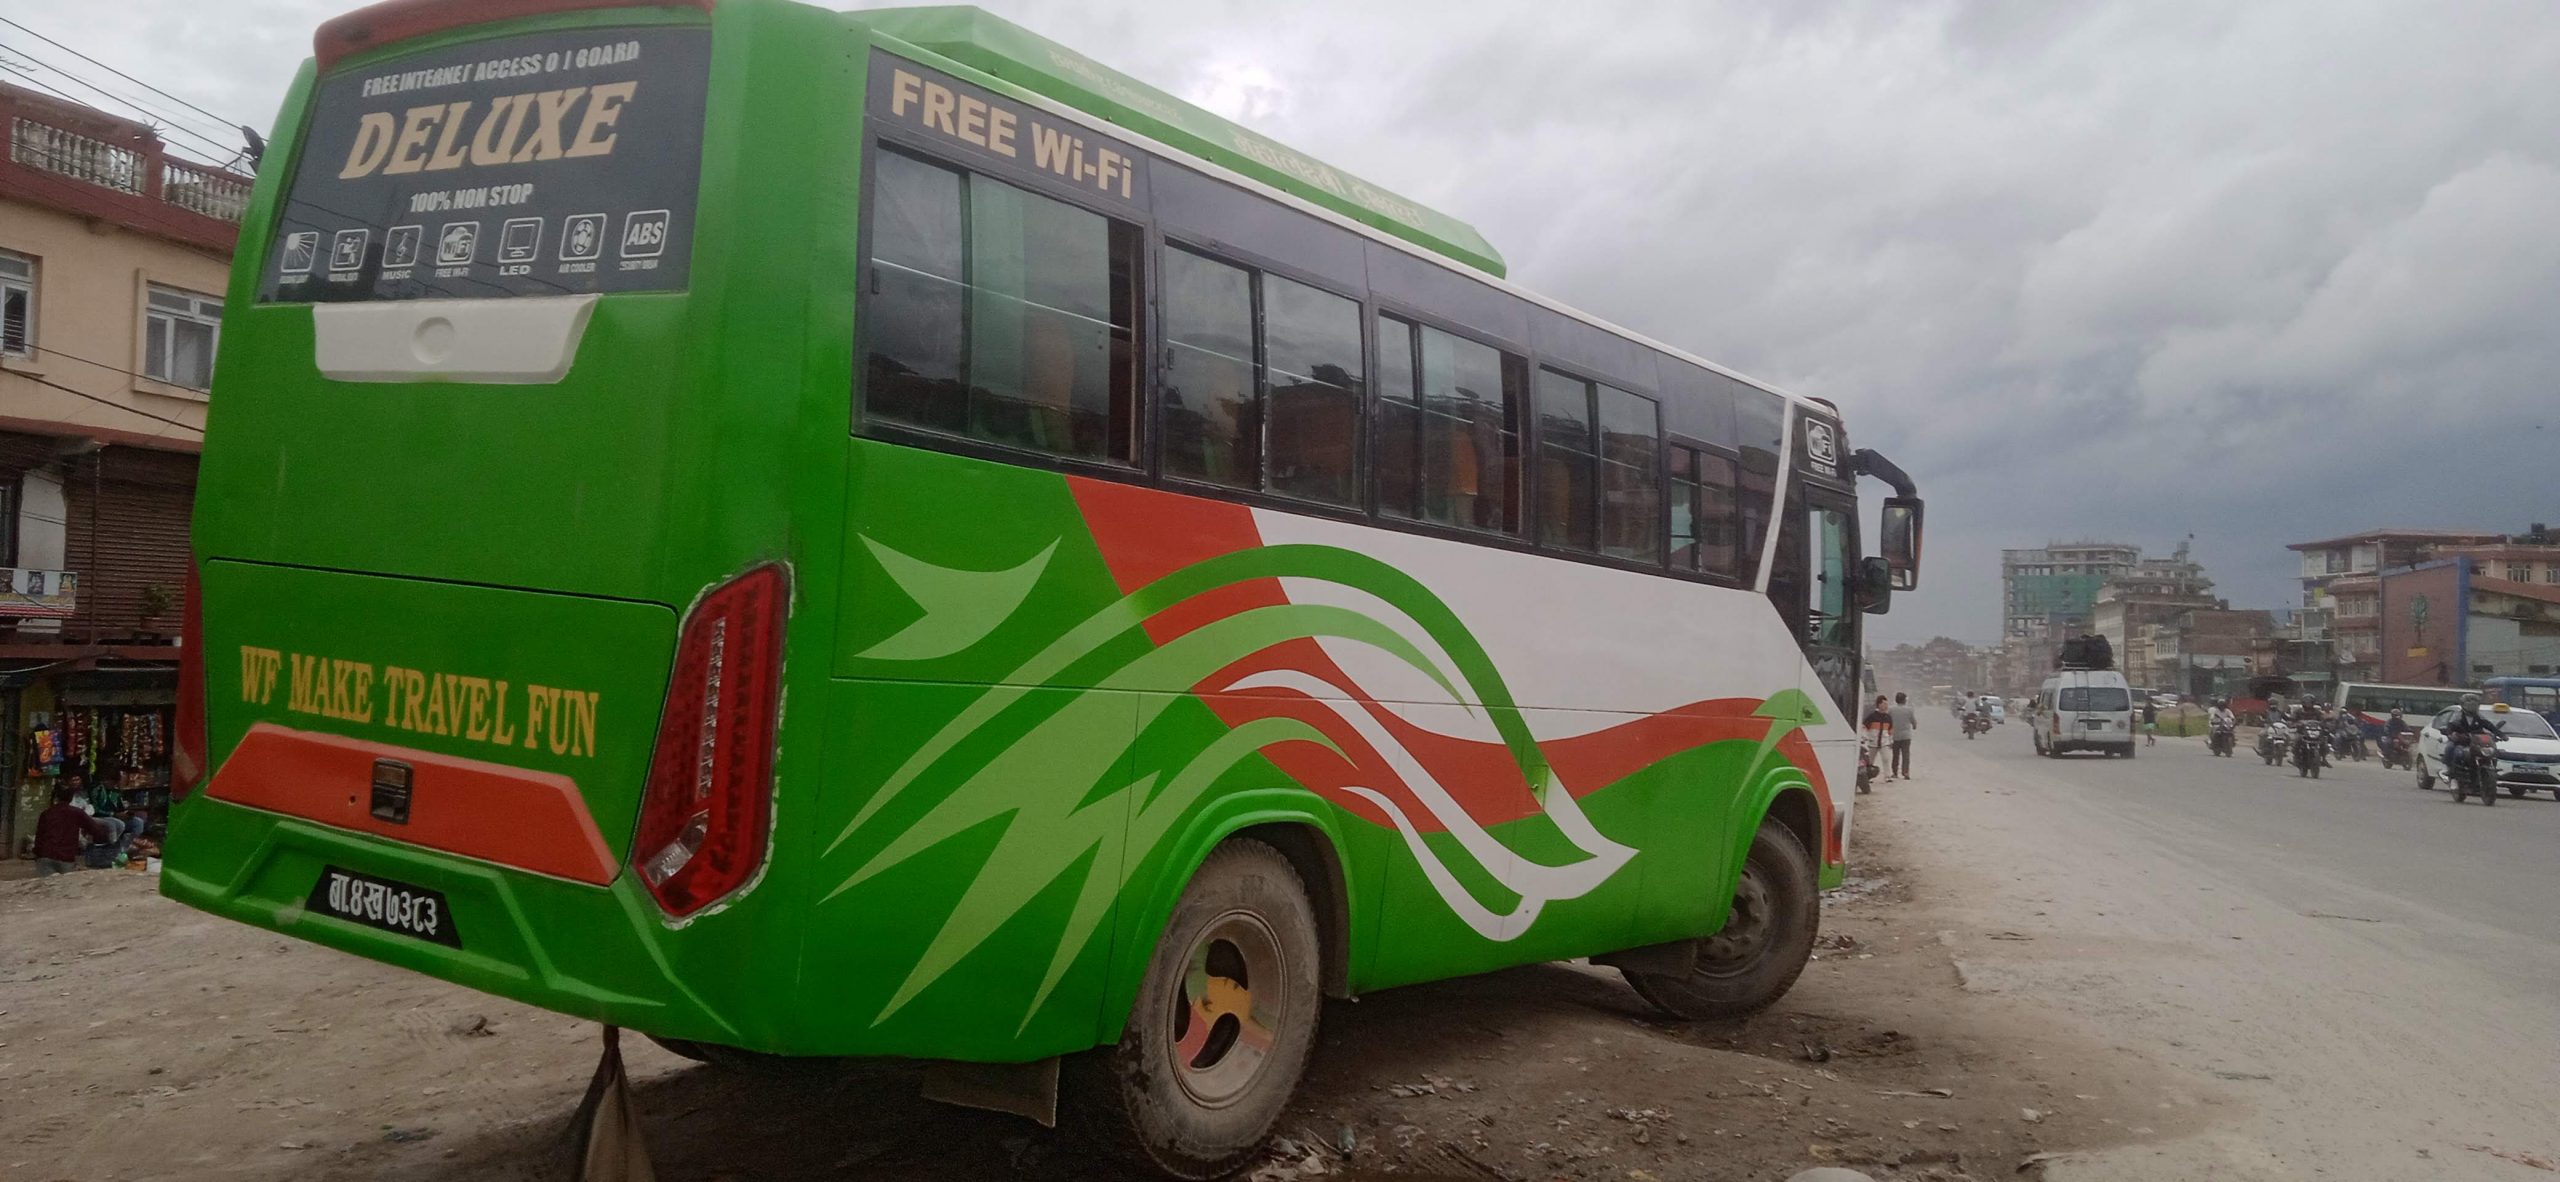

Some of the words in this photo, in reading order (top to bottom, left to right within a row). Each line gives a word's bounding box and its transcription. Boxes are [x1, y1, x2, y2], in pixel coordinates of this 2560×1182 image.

[362, 74, 400, 97] FREE
[473, 53, 543, 82] ACCESS
[338, 80, 638, 180] DELUXE
[892, 69, 1017, 158] FREE
[1032, 122, 1132, 199] Wi-Fi
[410, 190, 451, 212] 100%
[453, 187, 488, 209] NON
[489, 183, 534, 206] STOP
[626, 221, 663, 246] ABS
[382, 269, 411, 280] MUSIC
[435, 268, 452, 277] FREE
[499, 265, 531, 276] LED
[288, 653, 373, 724] MAKE
[384, 665, 515, 746] TRAVEL
[524, 684, 600, 758] FUN
